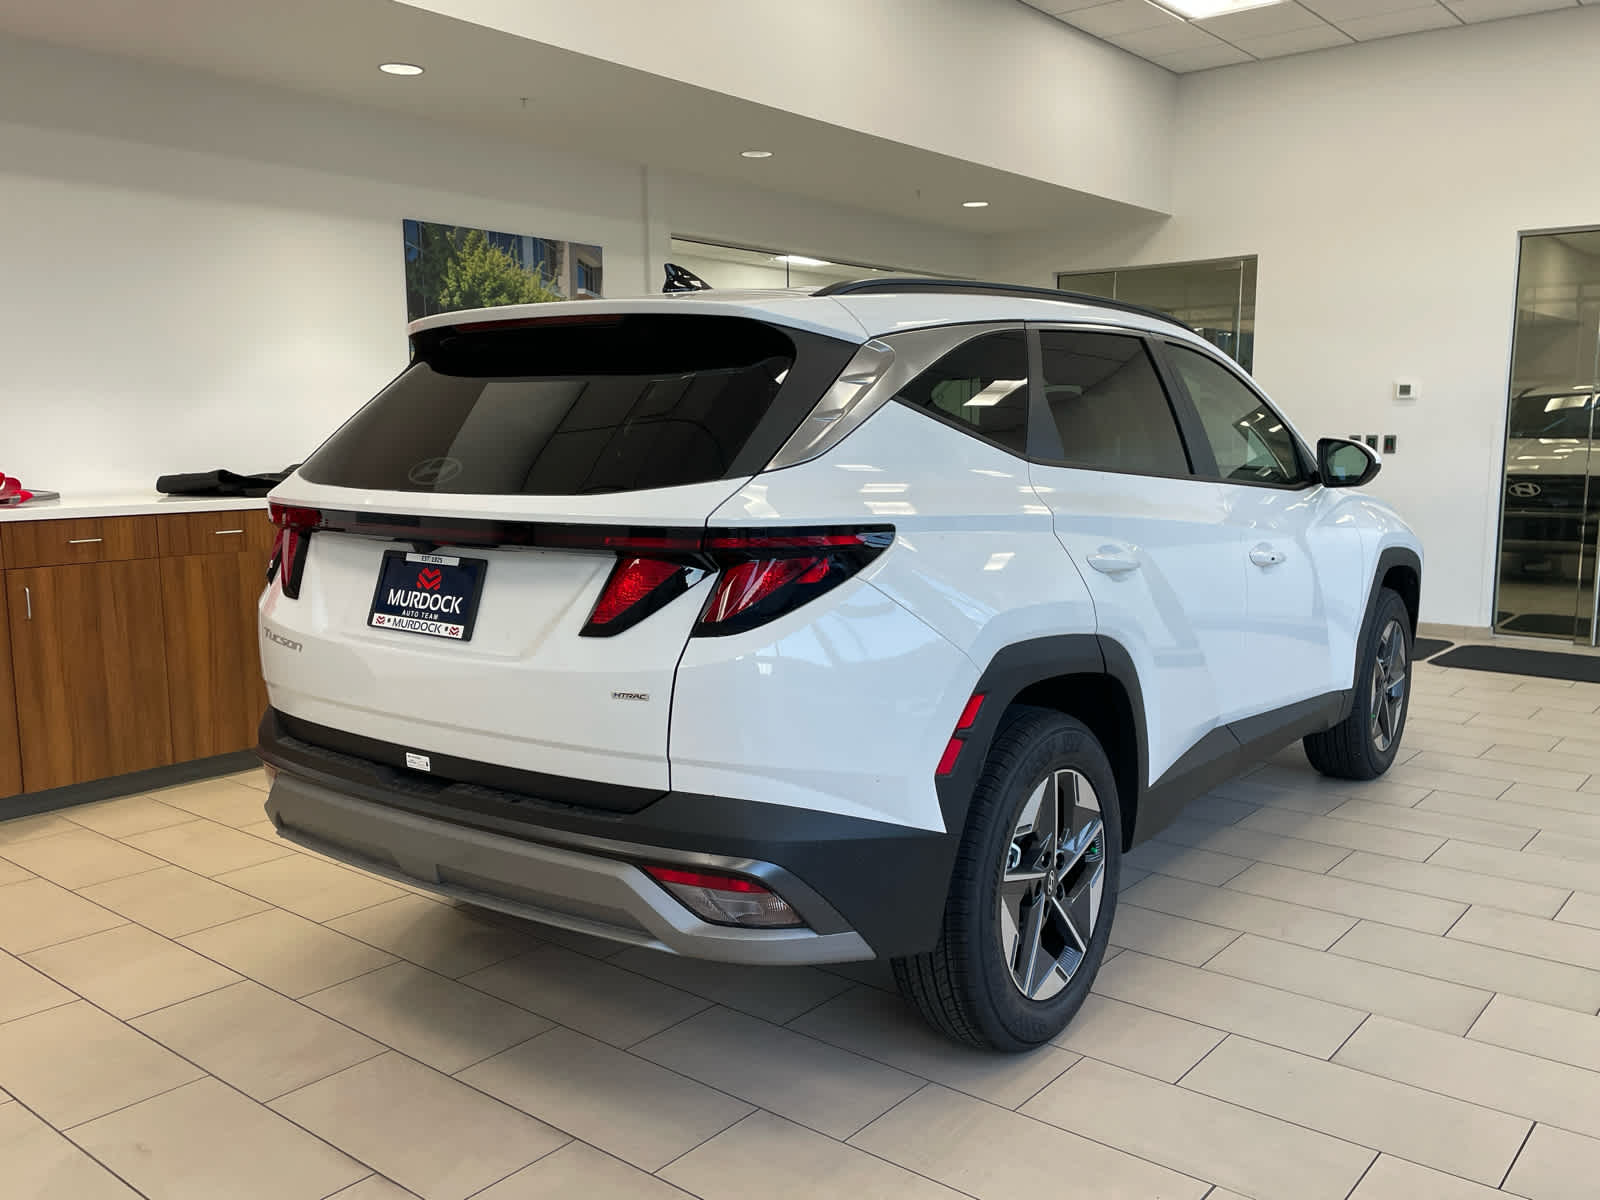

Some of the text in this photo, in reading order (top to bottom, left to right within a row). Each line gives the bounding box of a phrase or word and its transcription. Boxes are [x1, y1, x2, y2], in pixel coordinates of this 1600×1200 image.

[387, 588, 463, 614] MURDOCK
[401, 609, 439, 620] AUTO TEAM
[392, 617, 441, 634] MURDOCK
[612, 691, 649, 701] HTRAC
